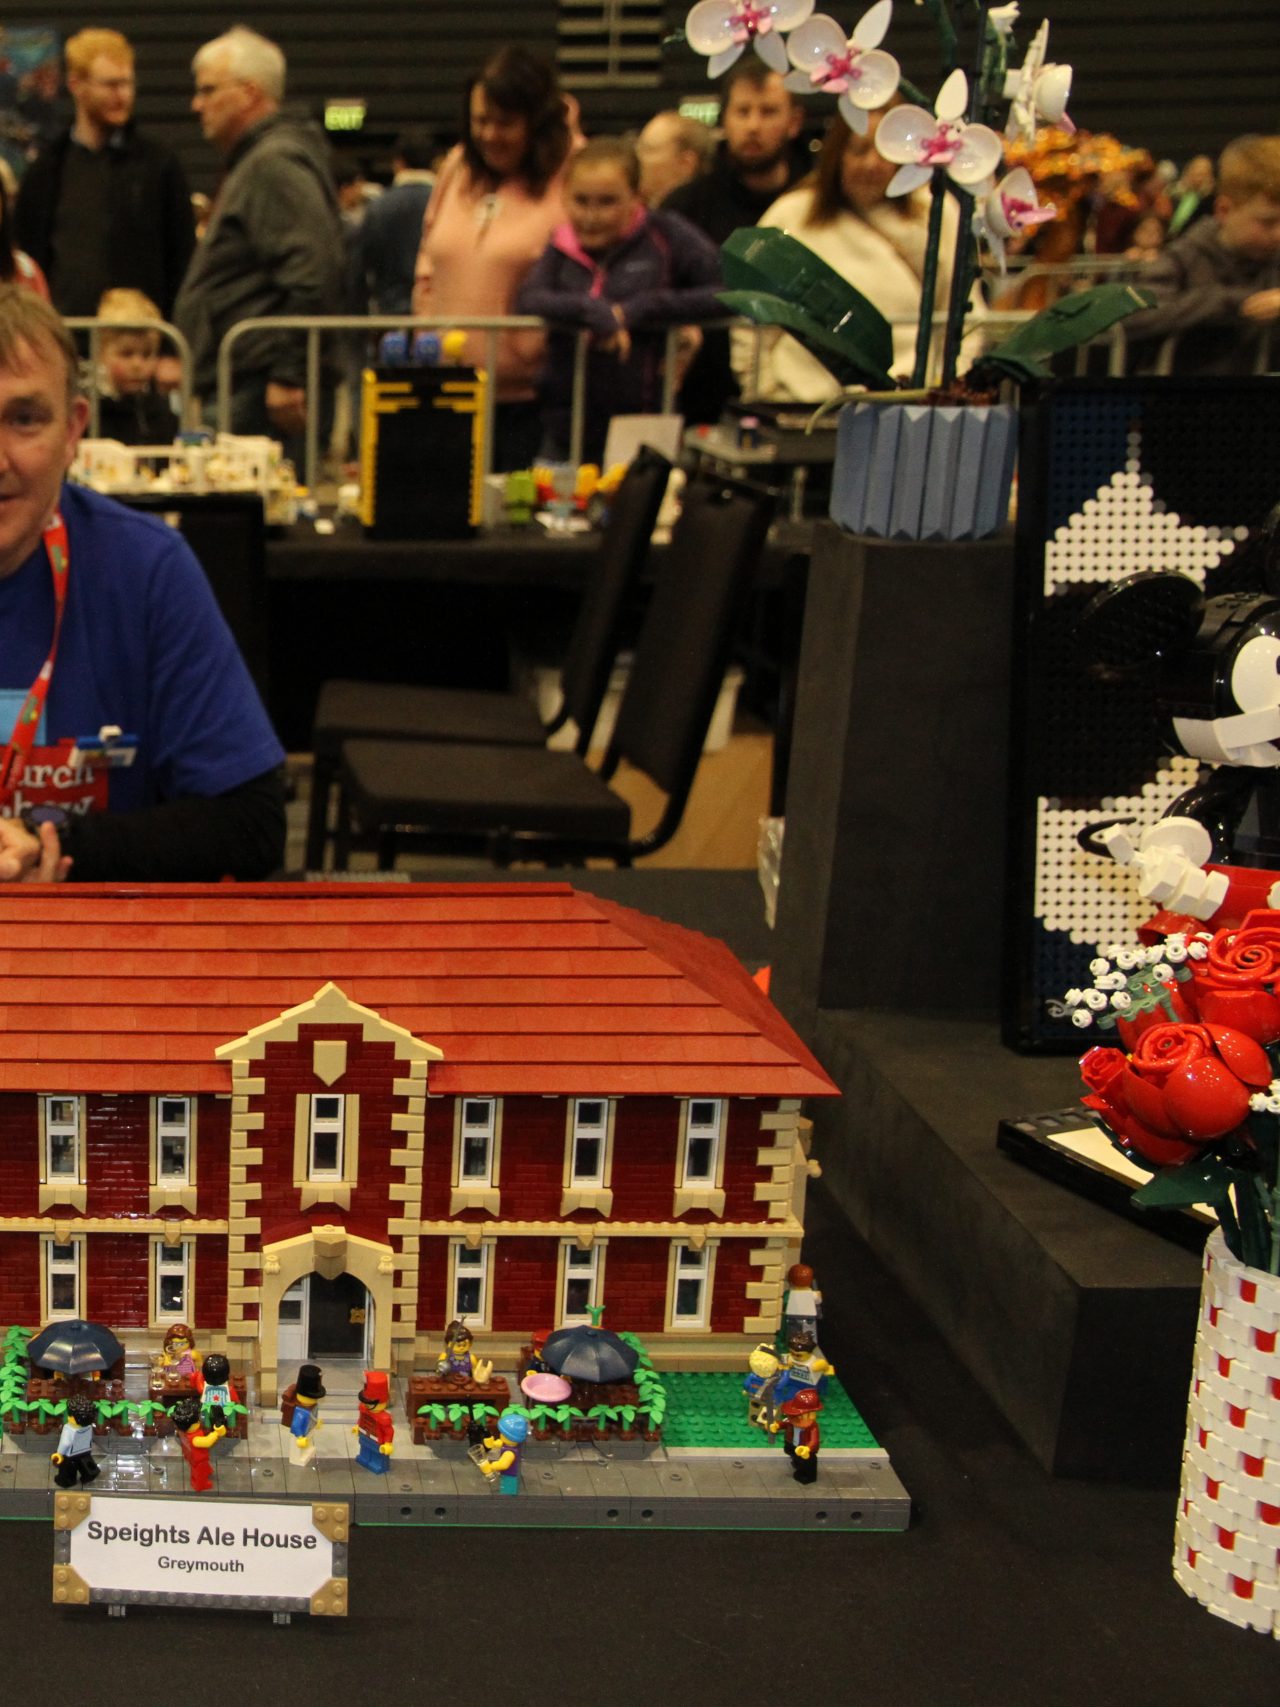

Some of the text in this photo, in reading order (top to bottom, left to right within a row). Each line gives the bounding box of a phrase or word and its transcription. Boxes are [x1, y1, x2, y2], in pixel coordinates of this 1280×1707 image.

[87, 1520, 317, 1549] Speights Ale House
[157, 1556, 245, 1573] Greymouth
